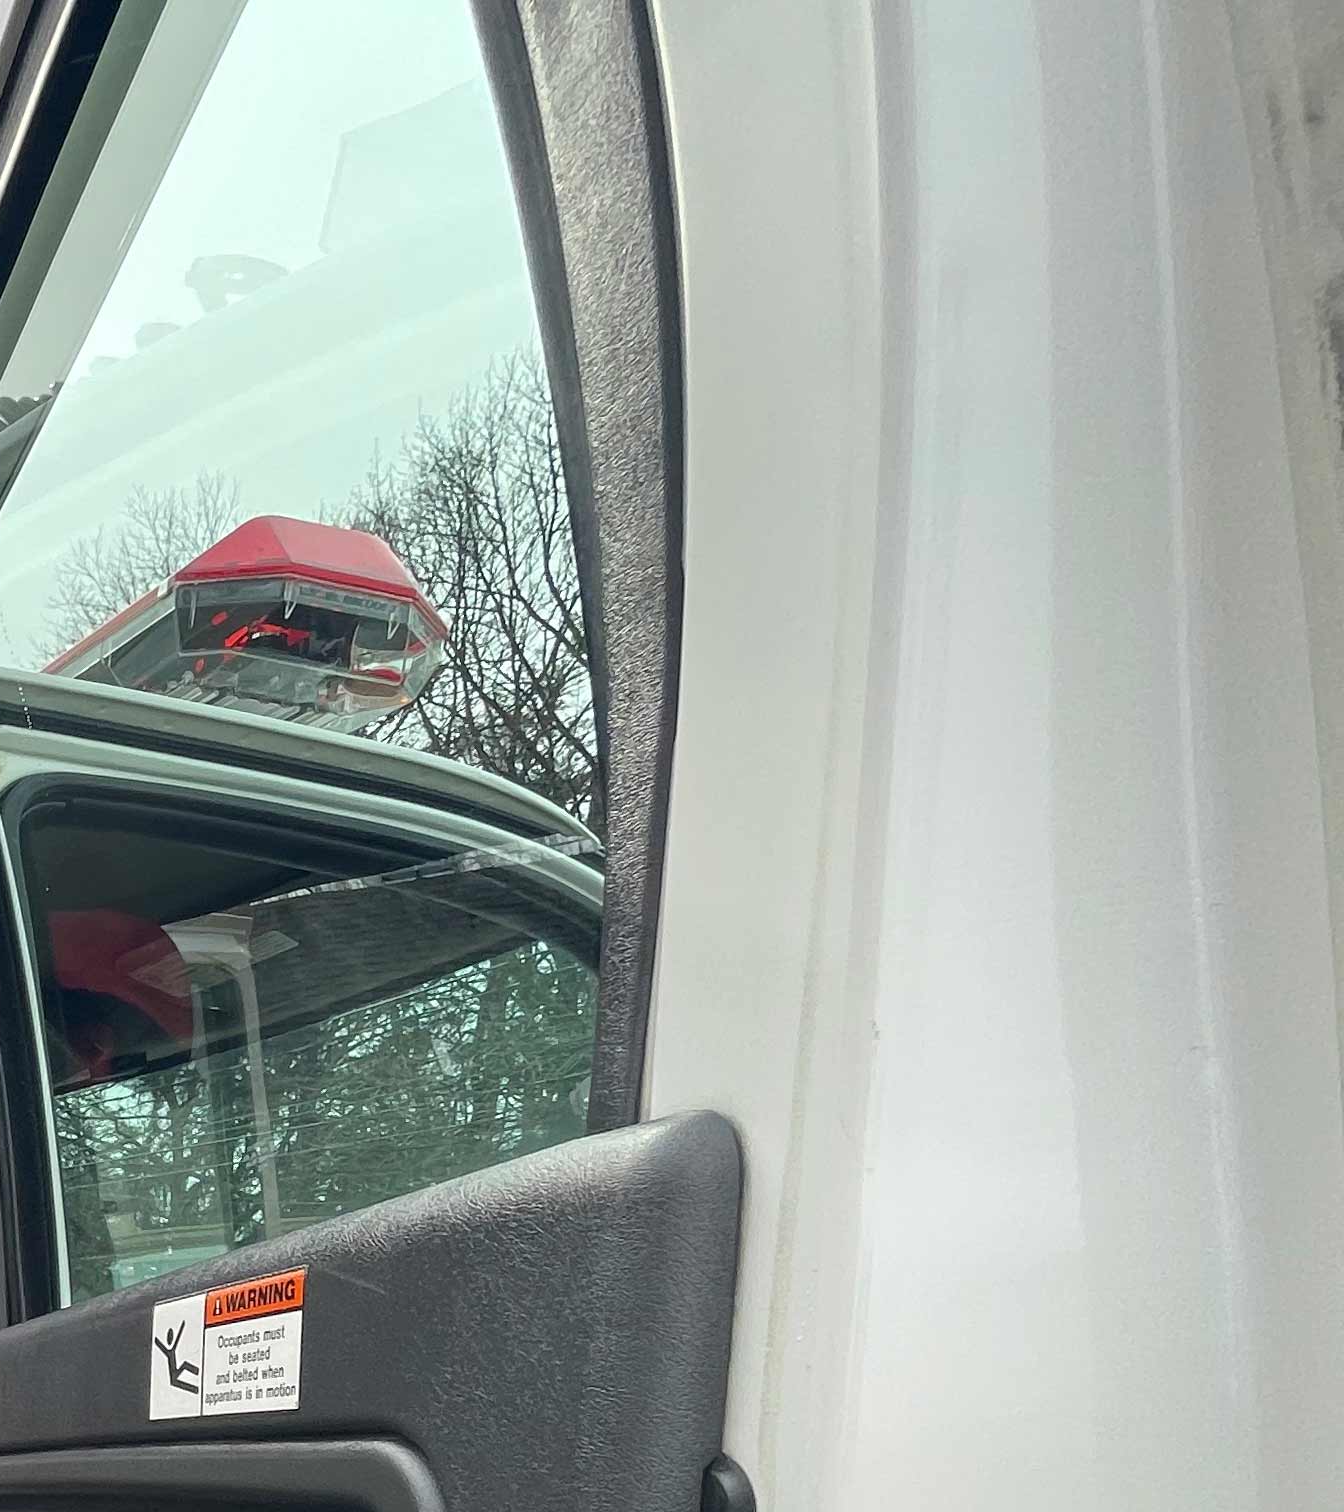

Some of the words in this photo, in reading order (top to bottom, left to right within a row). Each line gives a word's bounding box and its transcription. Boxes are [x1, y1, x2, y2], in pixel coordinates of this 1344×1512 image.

[226, 1280, 295, 1313] WARNING
[217, 1331, 260, 1348] Occupants
[263, 1325, 286, 1341] must
[228, 1352, 239, 1365] be
[242, 1346, 271, 1363] seated
[216, 1371, 230, 1385] and
[233, 1366, 259, 1383] belted
[262, 1365, 285, 1380] when
[205, 1390, 243, 1406] apparatus
[246, 1386, 253, 1400] is
[256, 1385, 263, 1399] in
[266, 1383, 297, 1398] motion
